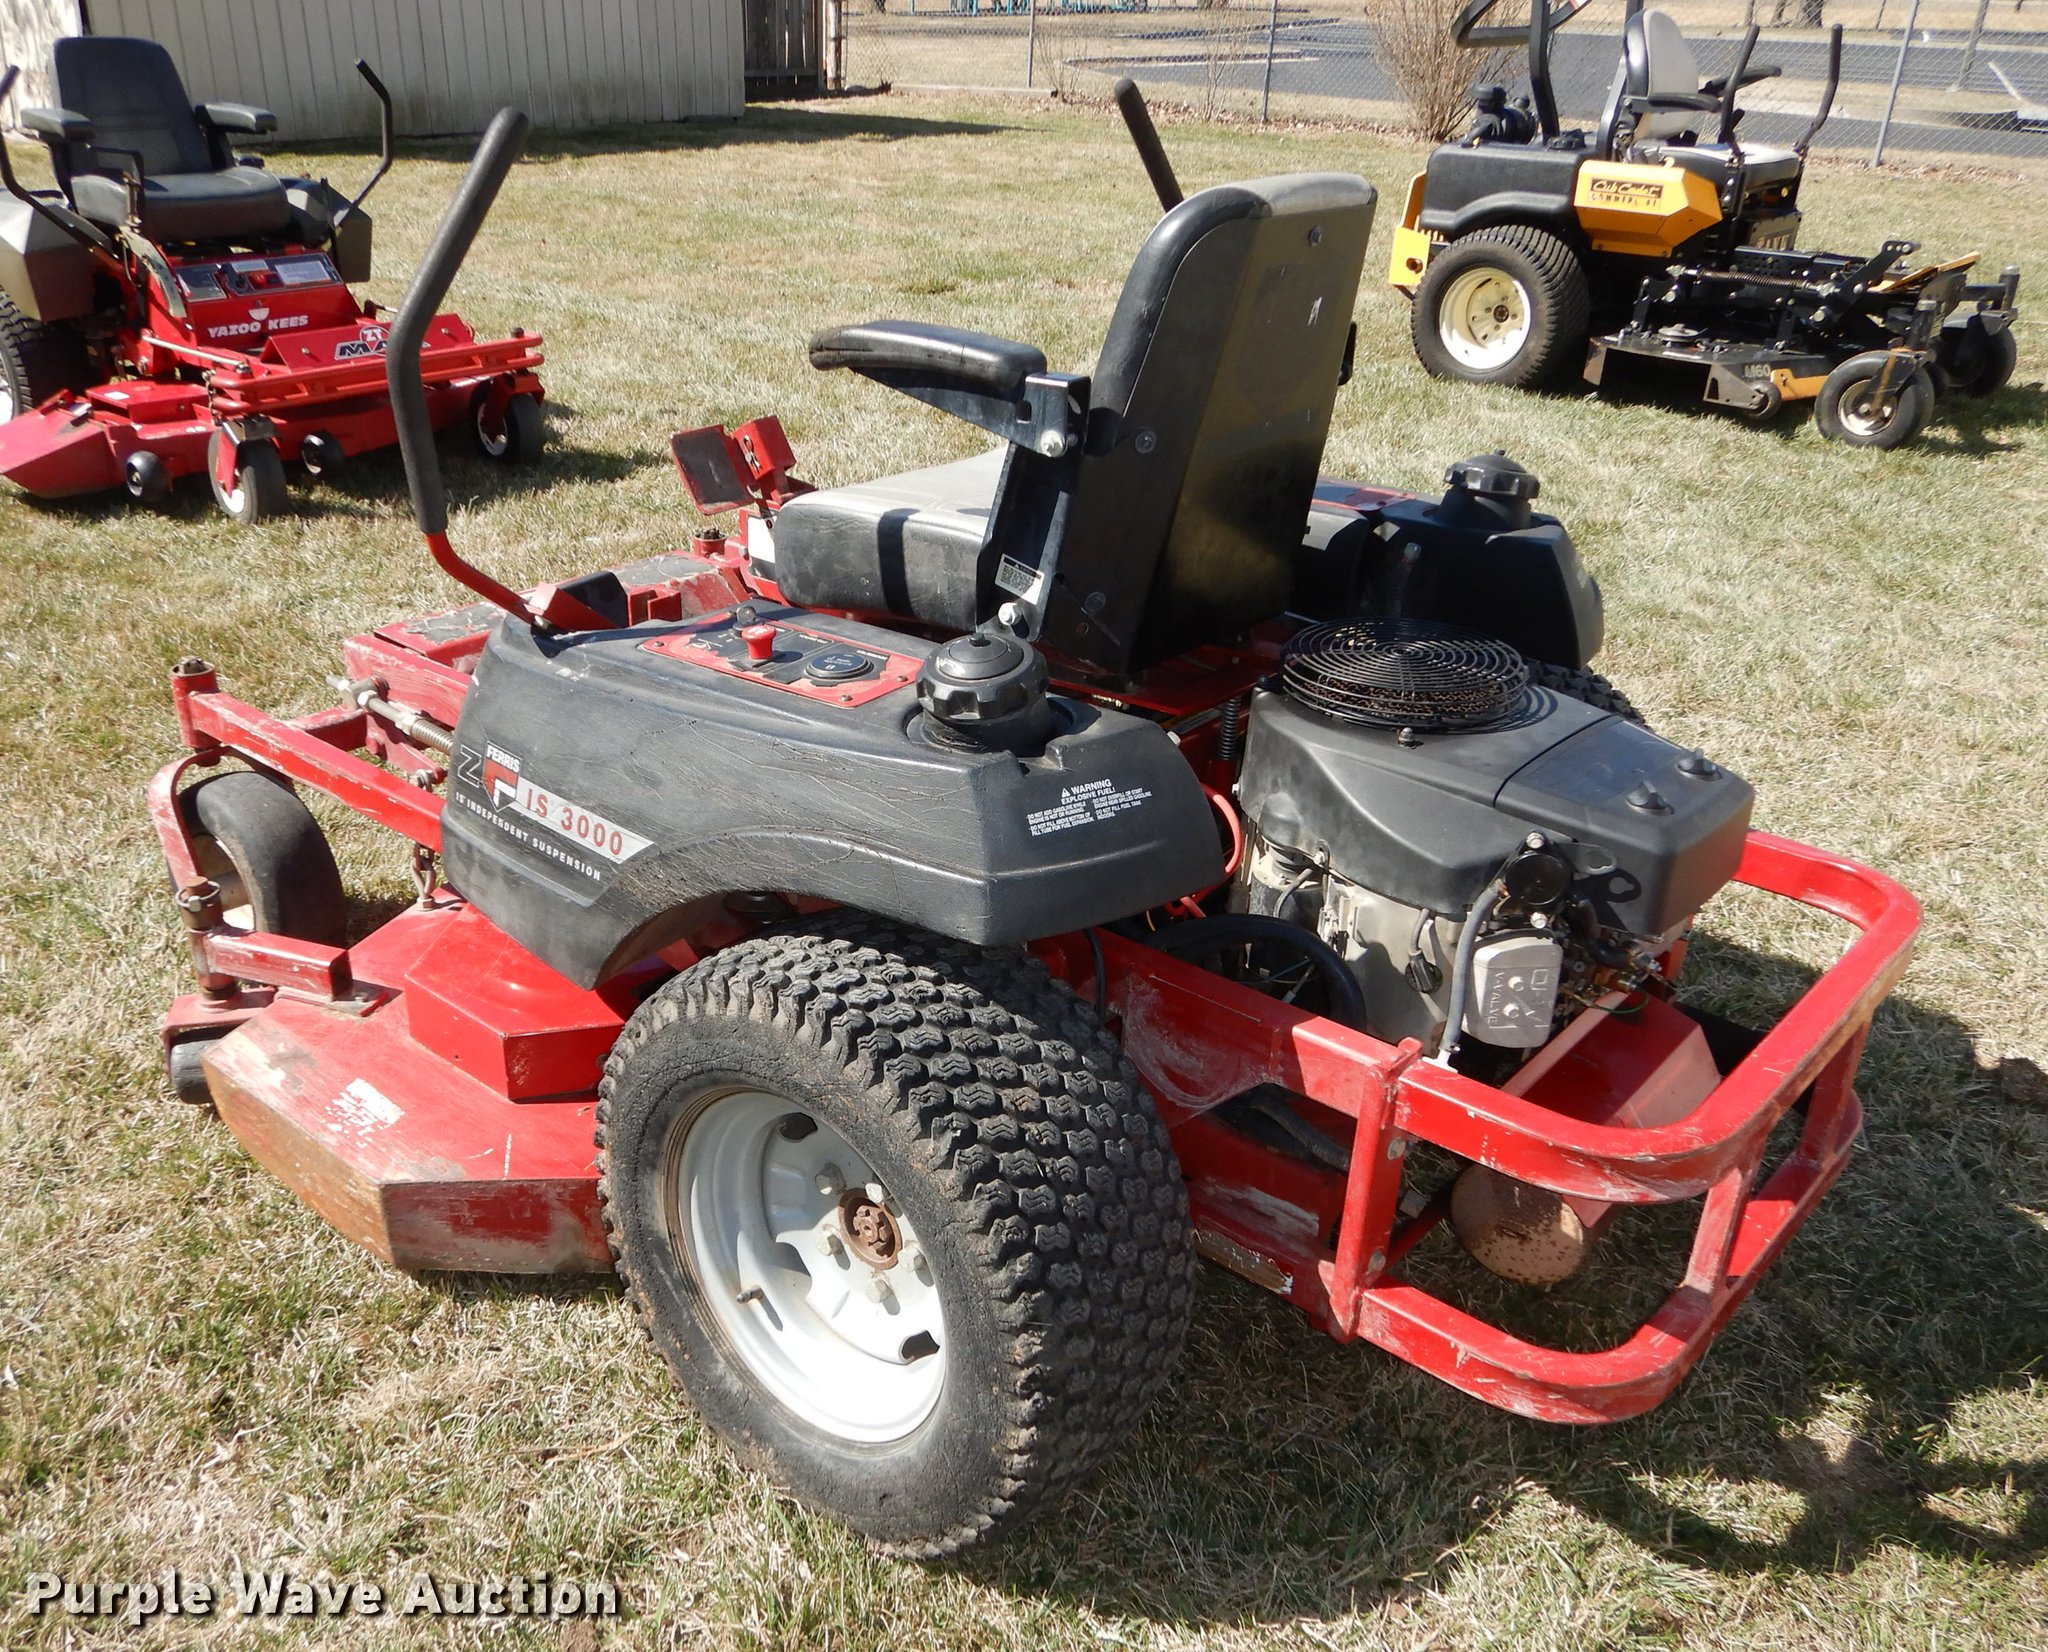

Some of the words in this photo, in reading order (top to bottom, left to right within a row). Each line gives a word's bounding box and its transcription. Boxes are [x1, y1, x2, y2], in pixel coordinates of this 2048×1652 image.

[207, 320, 262, 339] YAZOO
[267, 315, 309, 331] KEES
[363, 328, 384, 342] ZT
[1744, 363, 1771, 378] M60
[486, 744, 521, 773] FERRIS
[1061, 791, 1097, 805] EXPLOSIVE
[1097, 786, 1116, 797] FUEL!
[1071, 779, 1112, 795] WARNING
[526, 787, 549, 818] IS
[560, 806, 623, 856] 3000
[466, 795, 529, 843] INDEPENDENT
[532, 837, 601, 881] SUSPENSION
